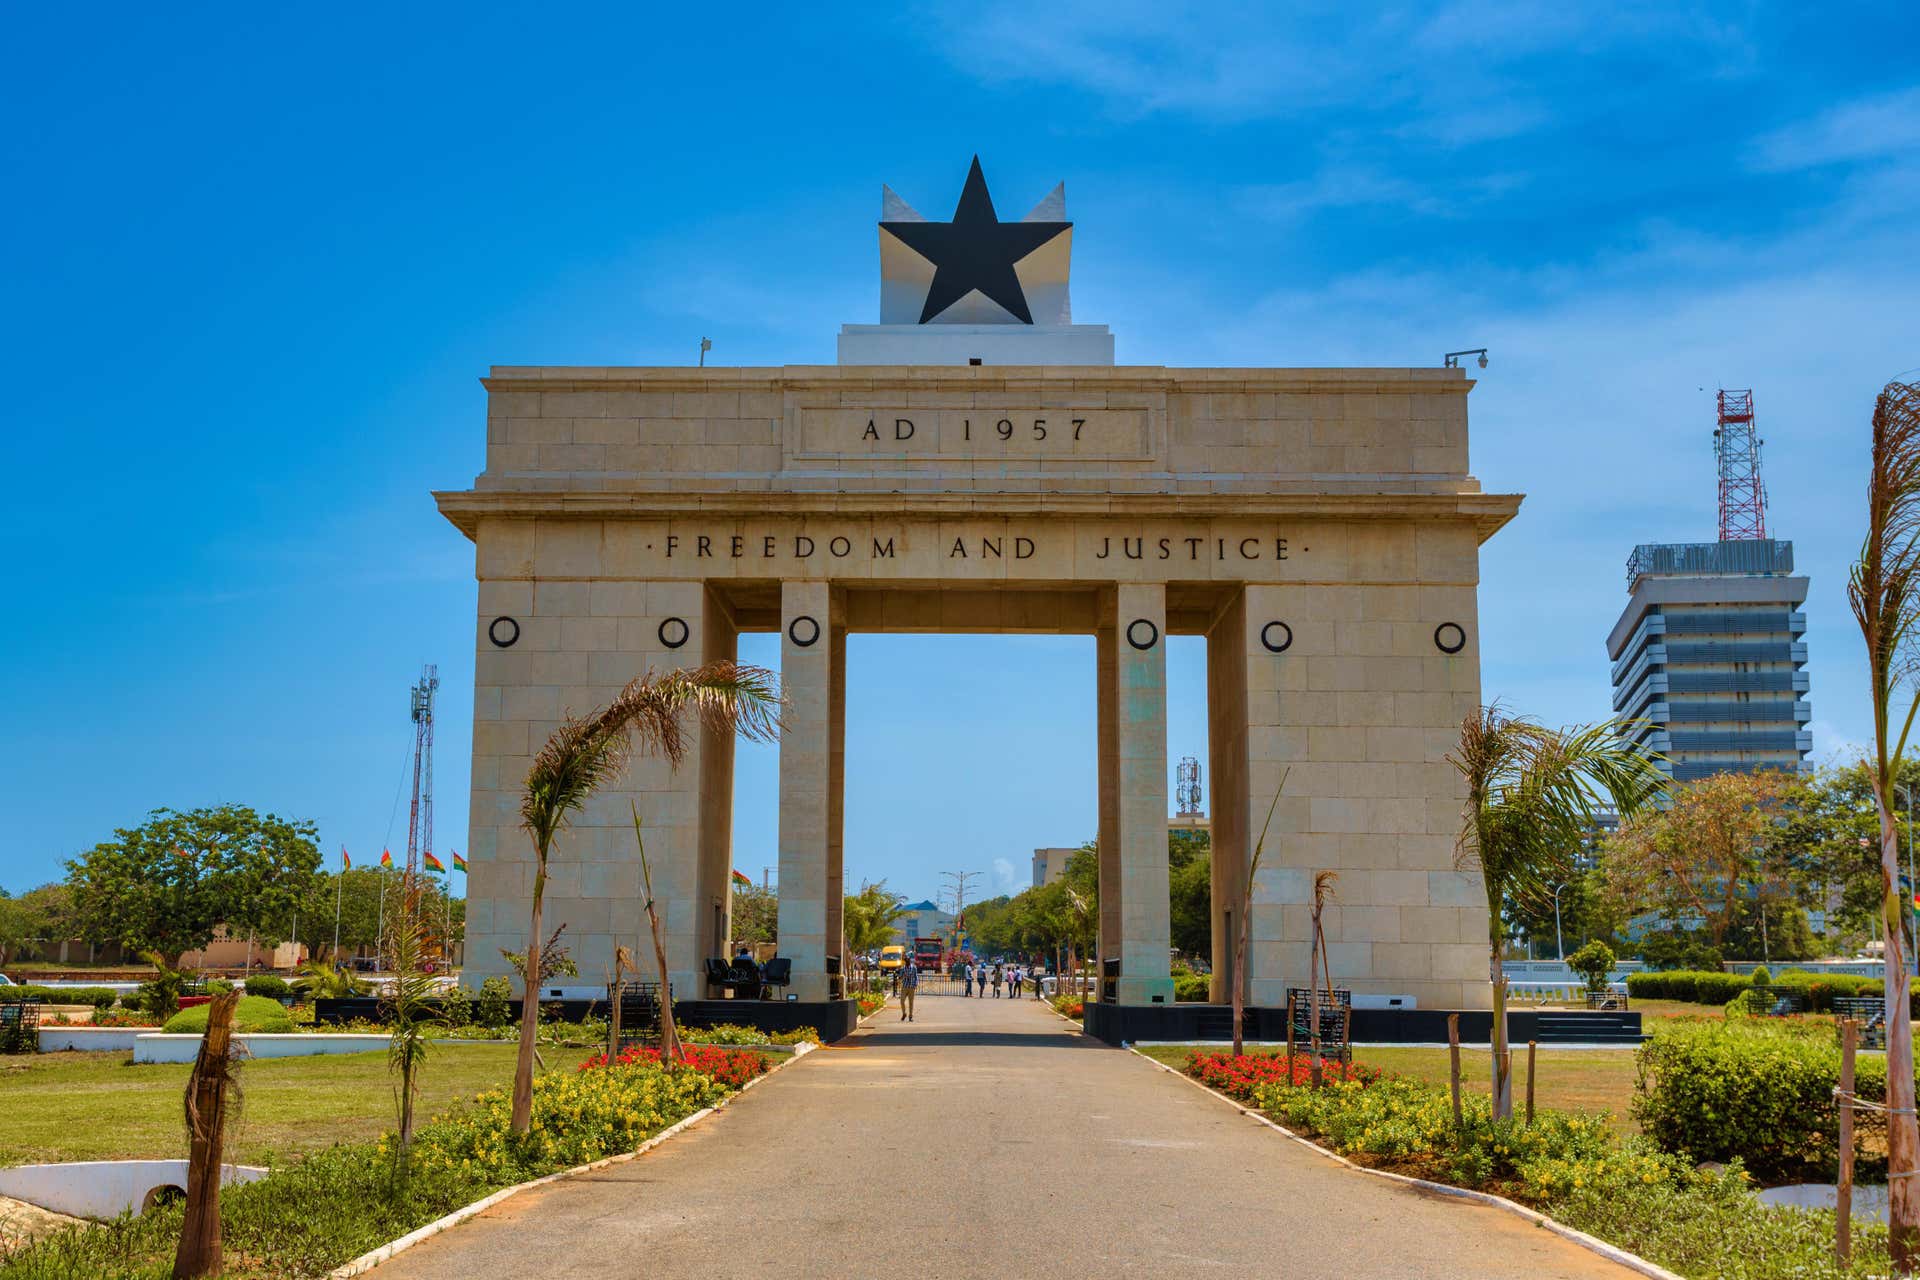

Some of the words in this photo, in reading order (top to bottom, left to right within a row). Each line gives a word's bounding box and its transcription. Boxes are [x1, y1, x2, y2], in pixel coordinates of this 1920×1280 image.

[862, 419, 915, 441] AD
[963, 419, 1086, 441] 1957
[666, 535, 895, 559] FREEDOM
[949, 537, 1036, 559] AND
[1096, 537, 1289, 561] JUSTICE
